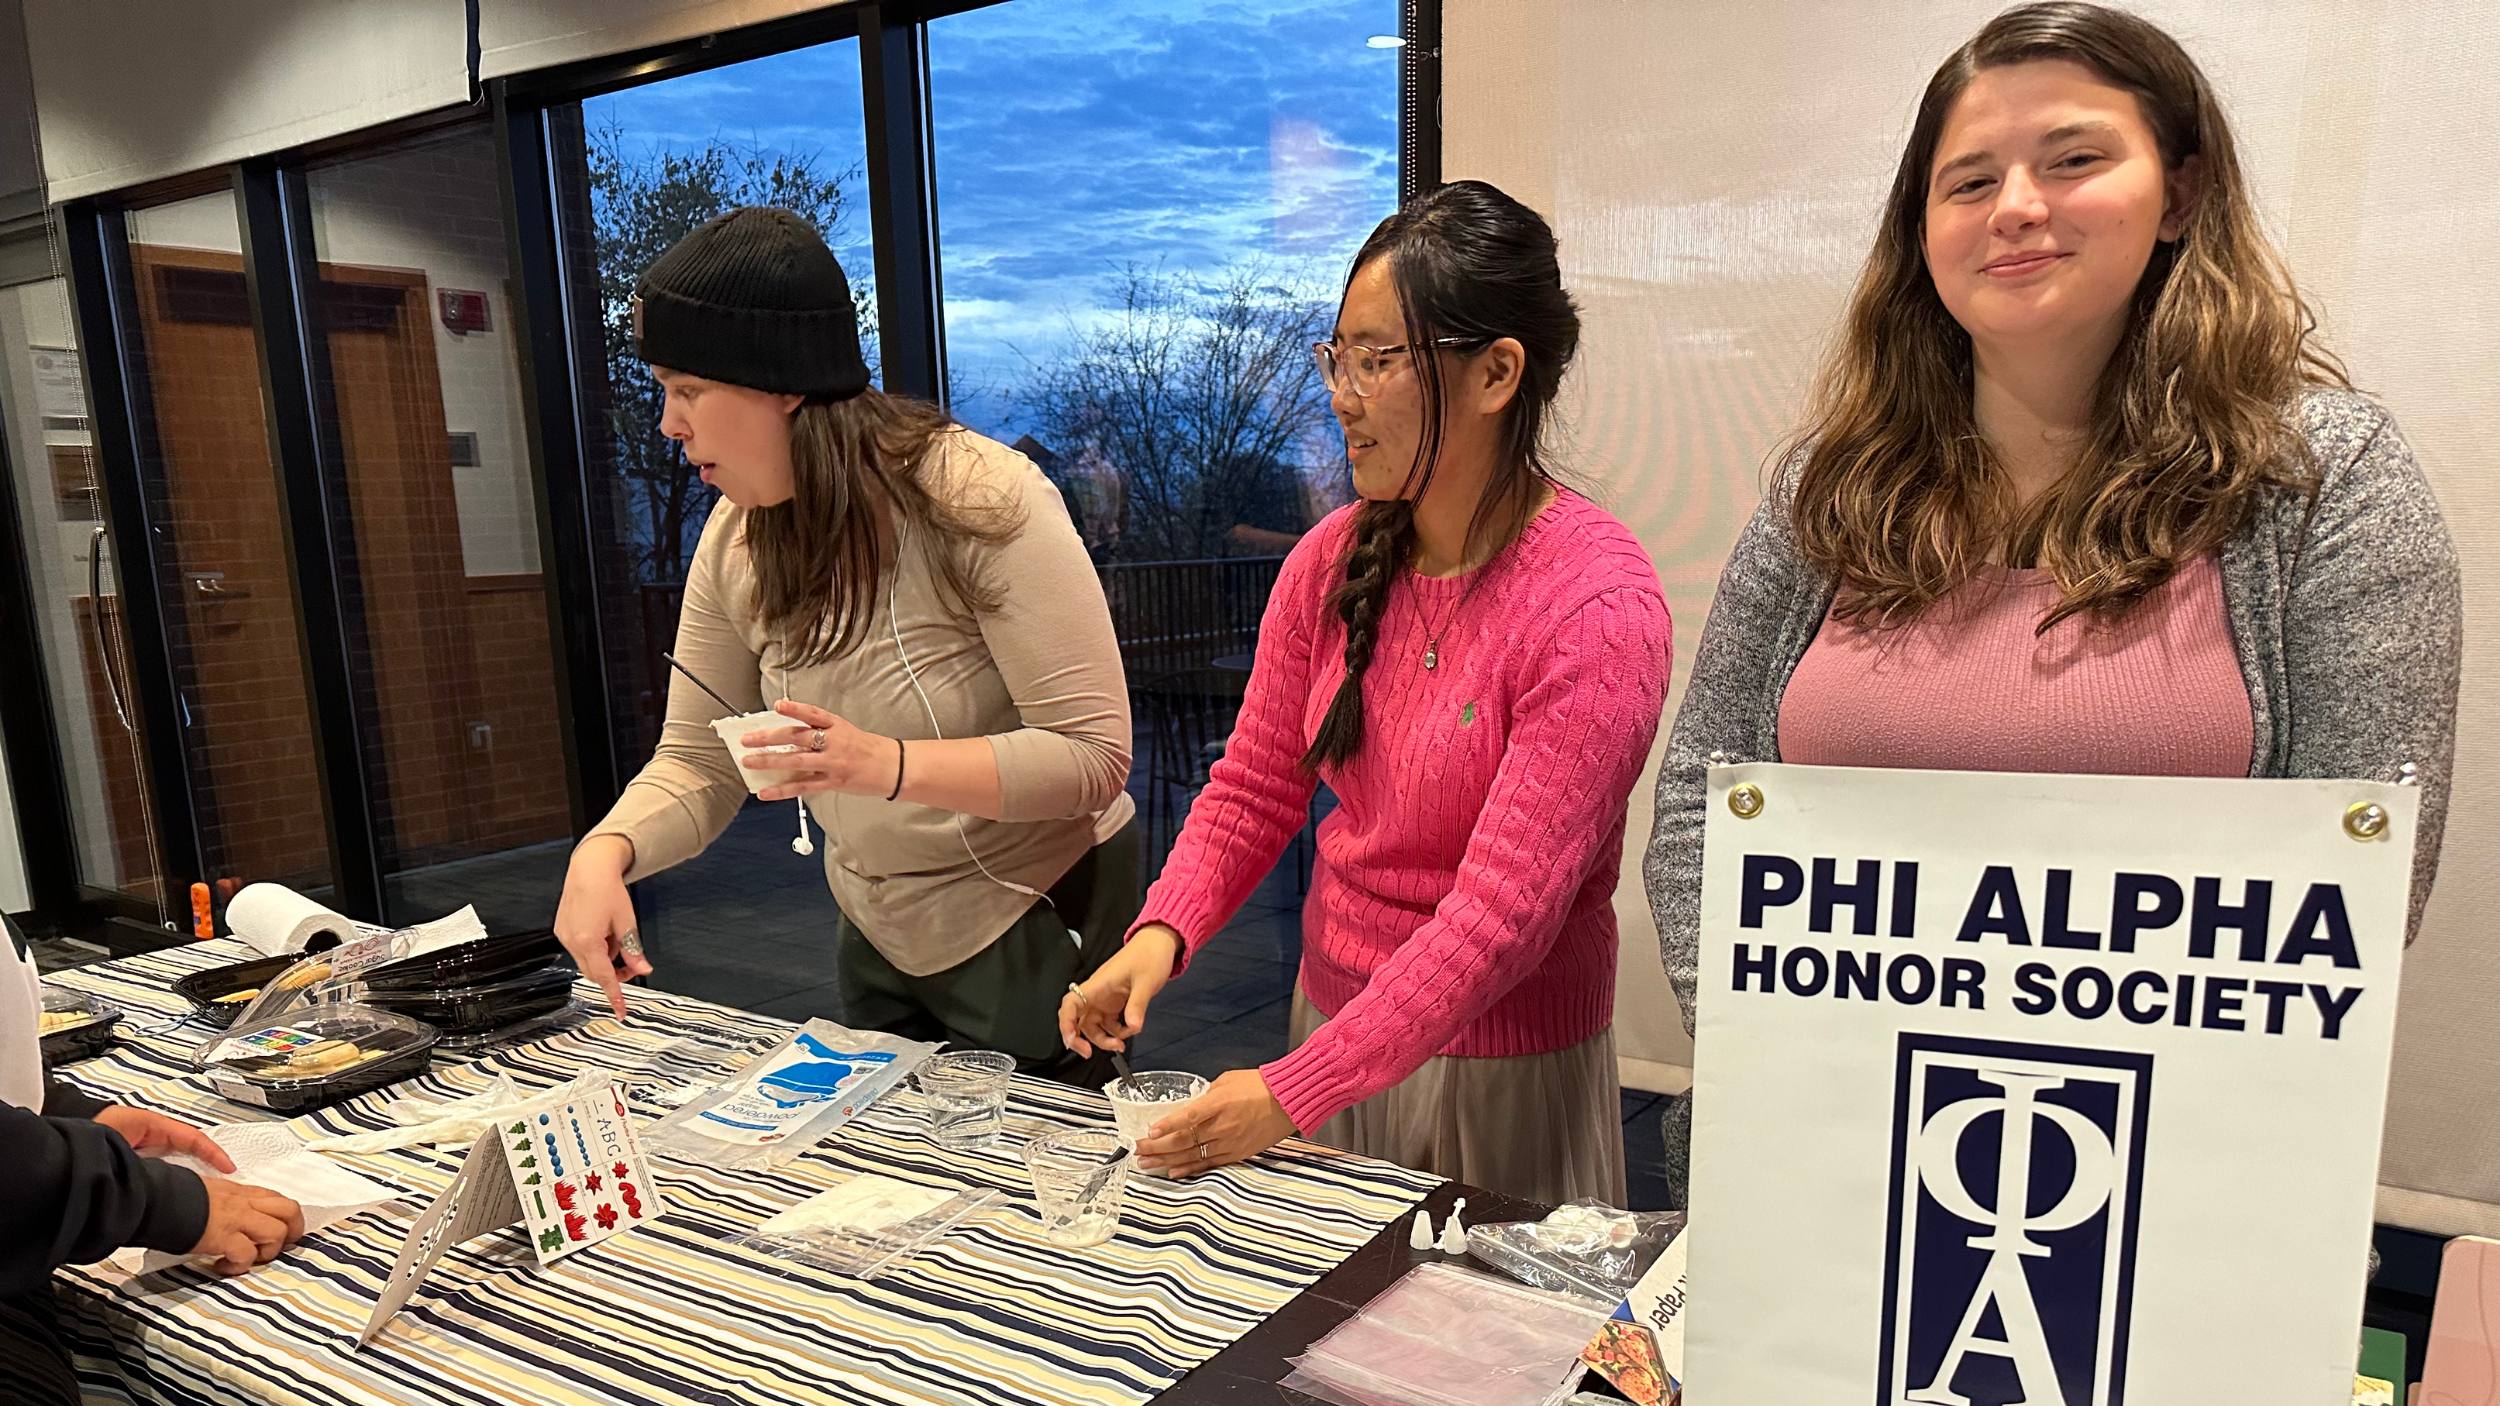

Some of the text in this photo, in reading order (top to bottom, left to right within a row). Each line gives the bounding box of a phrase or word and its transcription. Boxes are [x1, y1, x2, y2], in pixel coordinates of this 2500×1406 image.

[1738, 854, 2361, 970] PHI ALPHA
[337, 960, 364, 972] Cookie
[364, 953, 386, 965] Sugar
[1731, 943, 2364, 1040] HONOR SOCIETY
[720, 1103, 801, 1120] powdered
[597, 1118, 622, 1157] ABC
[1649, 1285, 1687, 1332] Paper
